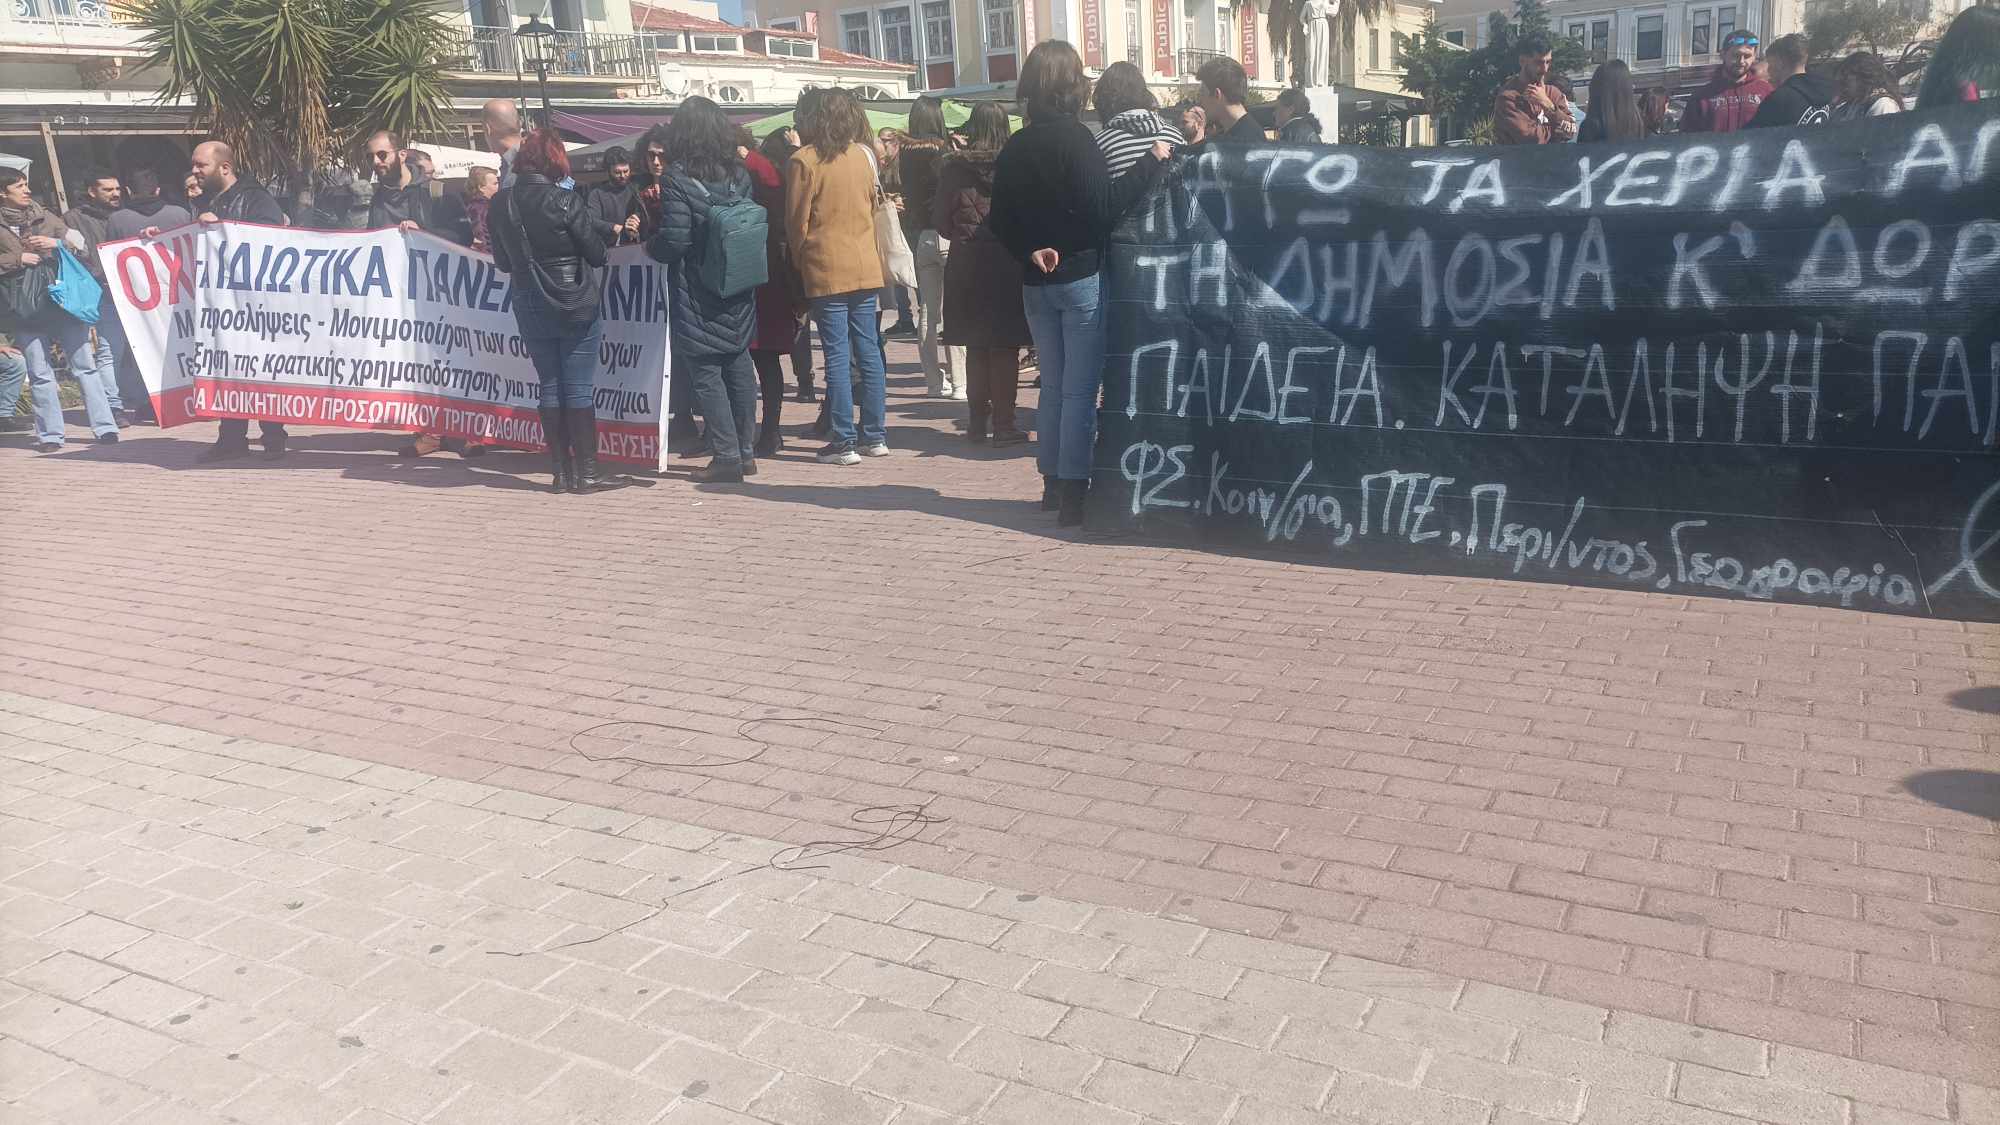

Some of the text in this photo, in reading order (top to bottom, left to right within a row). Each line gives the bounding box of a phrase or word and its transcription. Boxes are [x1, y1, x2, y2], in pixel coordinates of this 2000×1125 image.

[1084, 0, 1099, 53] Publi
[1157, 3, 1170, 59] Public
[1243, 14, 1255, 65] Public
[1410, 157, 1505, 213] ΤΑ
[1544, 139, 1826, 213] ΧΕΡΙΑ
[216, 240, 393, 298] ΙΔΙΩΤΙΚΑ
[1261, 216, 1616, 329] ΔΗΜΟΣΙΑ
[199, 302, 312, 343] προσλήψεις
[329, 307, 473, 357] Μονιμοποίηση
[474, 328, 505, 358] των
[233, 354, 259, 378] της
[262, 350, 346, 386] κρατικής
[347, 355, 502, 401] χρηματοδότησης
[504, 379, 524, 402] για
[1125, 338, 1405, 430] ΠΑΙΔΕΙΑ.
[1435, 322, 1823, 444] ΚΑΤΑΛΗΨΗ
[211, 388, 319, 418] ΔΙΟΙΚΗΤΙΚΟΥ
[320, 395, 440, 428] ΠΡΟΣΩΠΙΚΟΥ
